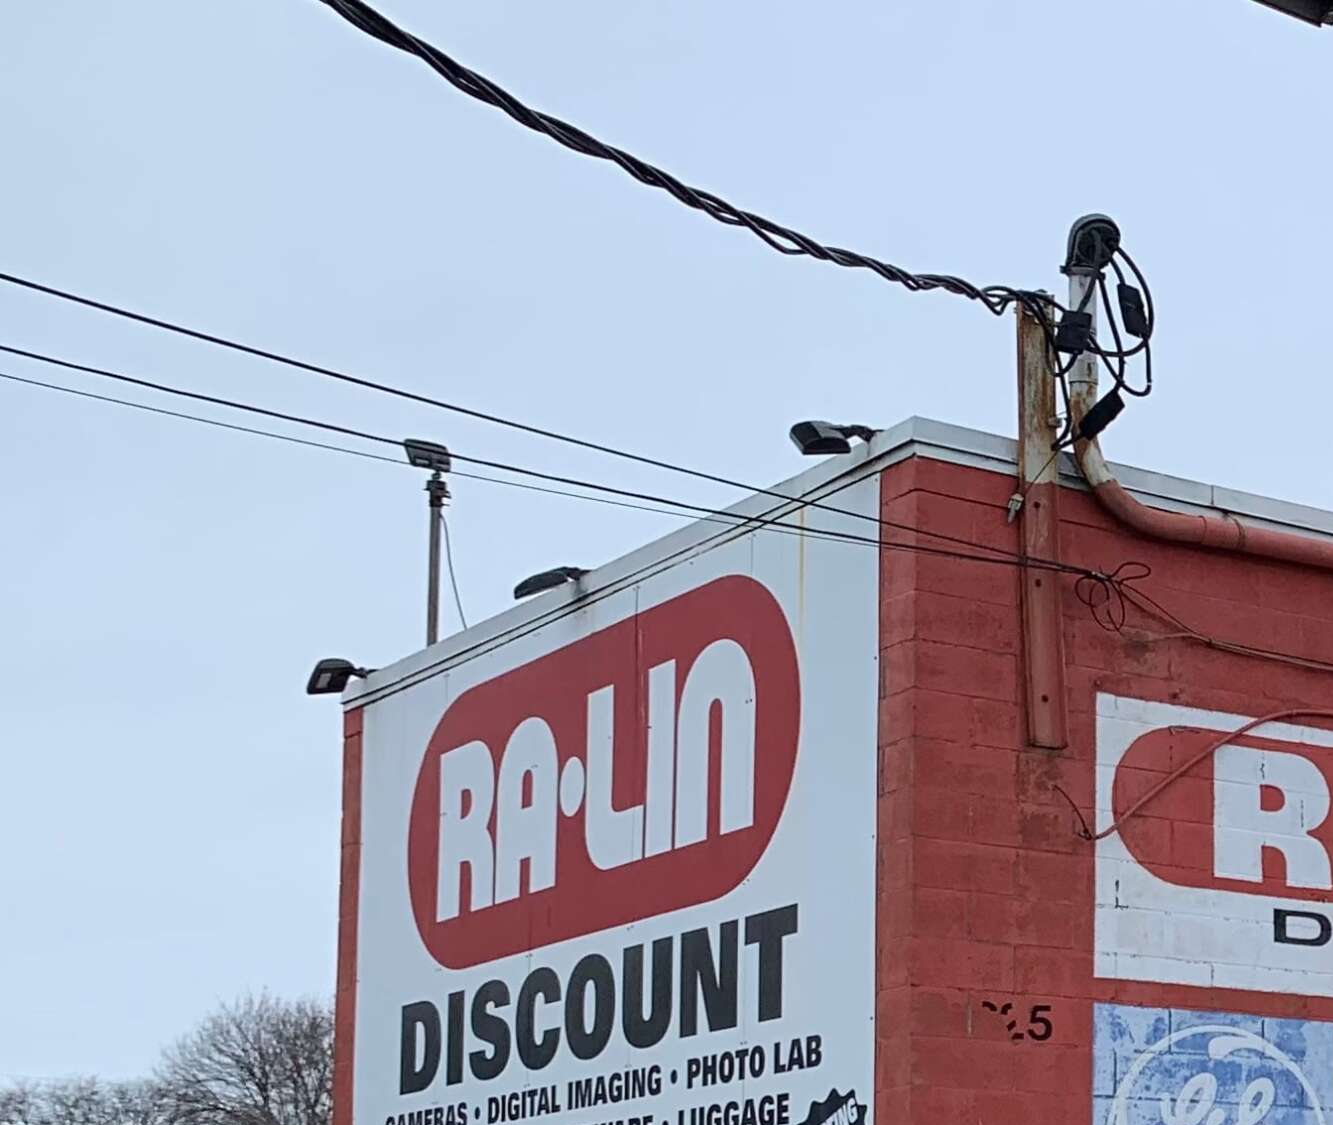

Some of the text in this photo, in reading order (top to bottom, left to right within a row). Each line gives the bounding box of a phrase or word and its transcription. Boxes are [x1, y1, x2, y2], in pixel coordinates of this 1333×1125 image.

[400, 903, 799, 1096] DISCOUNT
[487, 1084, 561, 1125] DIGITAL
[567, 1065, 662, 1111] IMAGING
[686, 1045, 766, 1090] PHOTO
[773, 1034, 823, 1075] LAB
